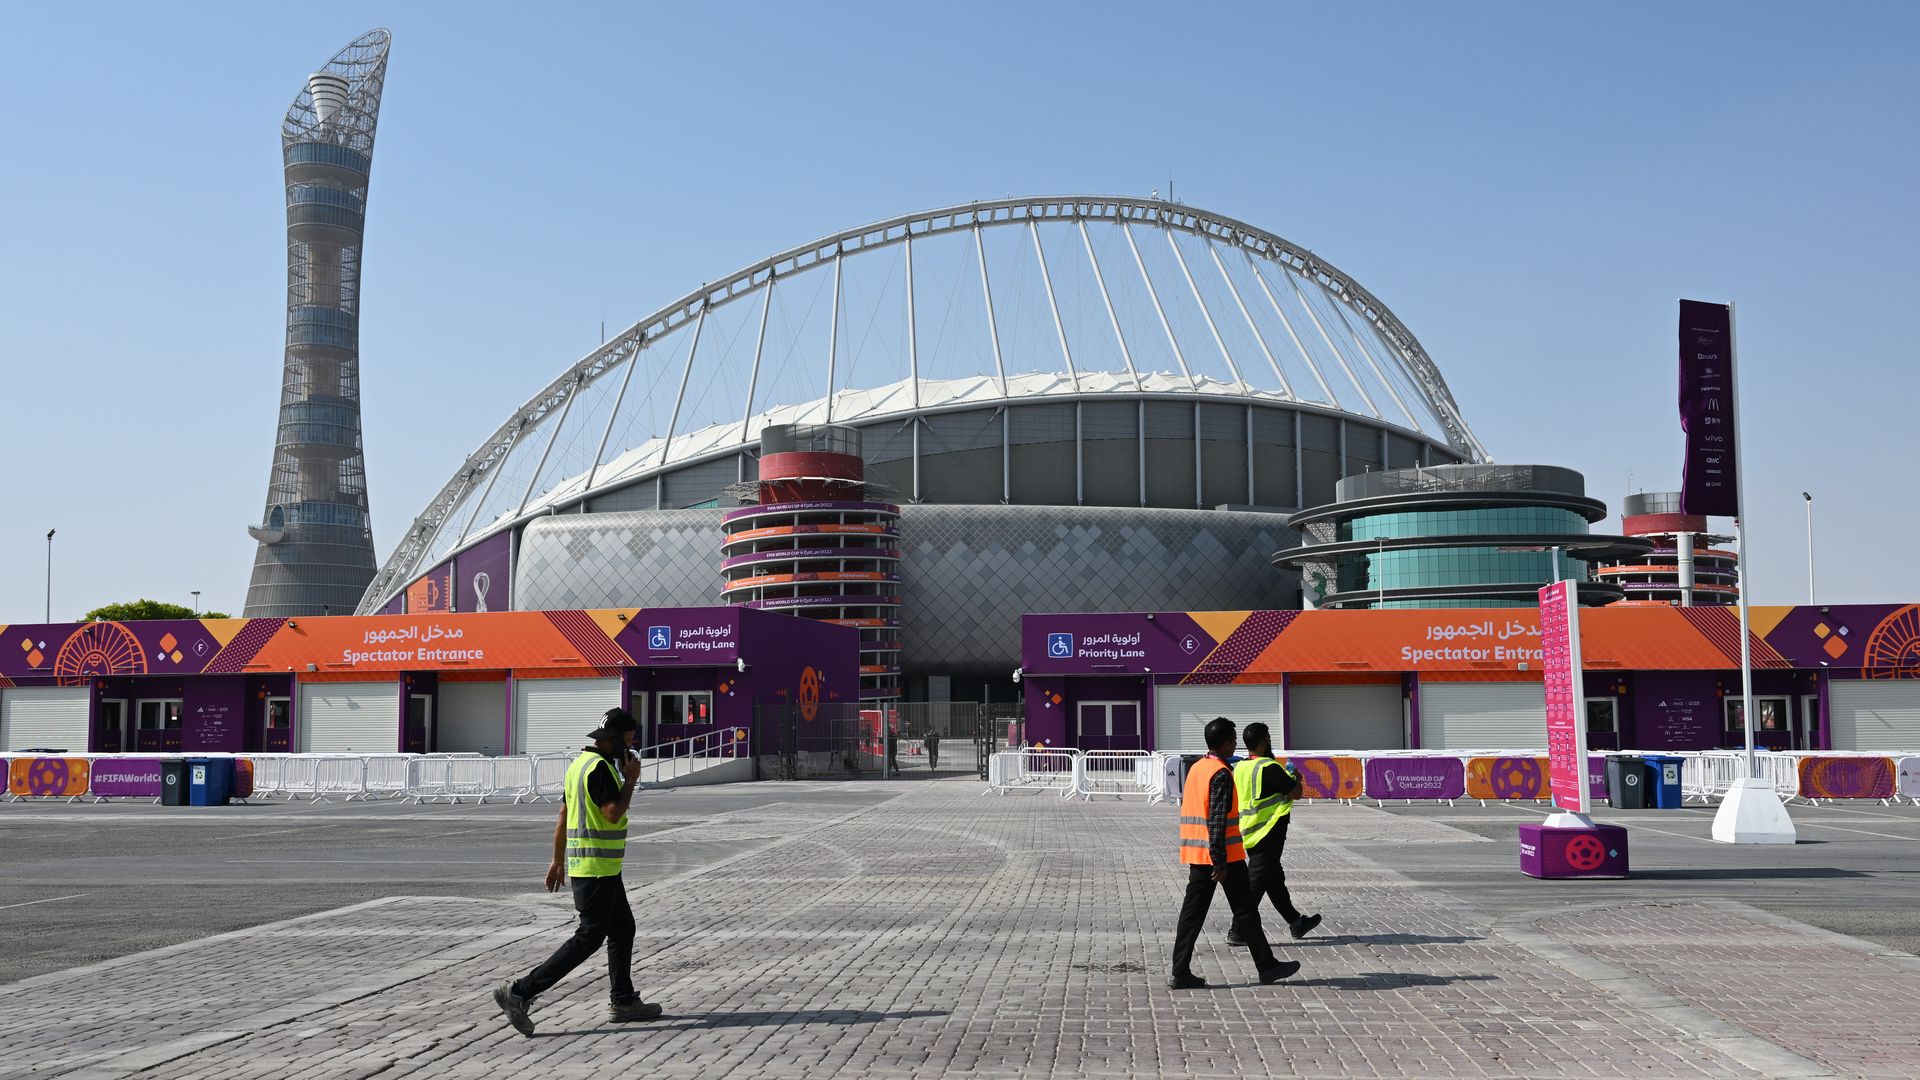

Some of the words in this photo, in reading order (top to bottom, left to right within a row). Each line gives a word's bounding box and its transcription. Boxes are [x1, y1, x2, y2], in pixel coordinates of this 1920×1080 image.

[363, 625, 418, 644] الجمهور
[421, 624, 464, 642] مدخل
[679, 627, 704, 638] المرور
[705, 624, 731, 638] أولوية
[1426, 621, 1493, 641] الجمهور
[1498, 620, 1542, 640] دخل
[675, 641, 711, 651] Priority
[712, 640, 735, 649] Lane
[1082, 634, 1110, 646] المرور
[1112, 632, 1140, 646] أولوية
[1186, 640, 1193, 649] E
[198, 643, 204, 652] F
[1078, 649, 1118, 660] Priority
[1120, 648, 1145, 658] Lane
[1401, 646, 1490, 664] Spectator
[1494, 645, 1543, 660] Entra
[343, 649, 415, 666] Spectator
[417, 647, 484, 661] Entrance
[94, 773, 162, 783] #FIFAWorldC
